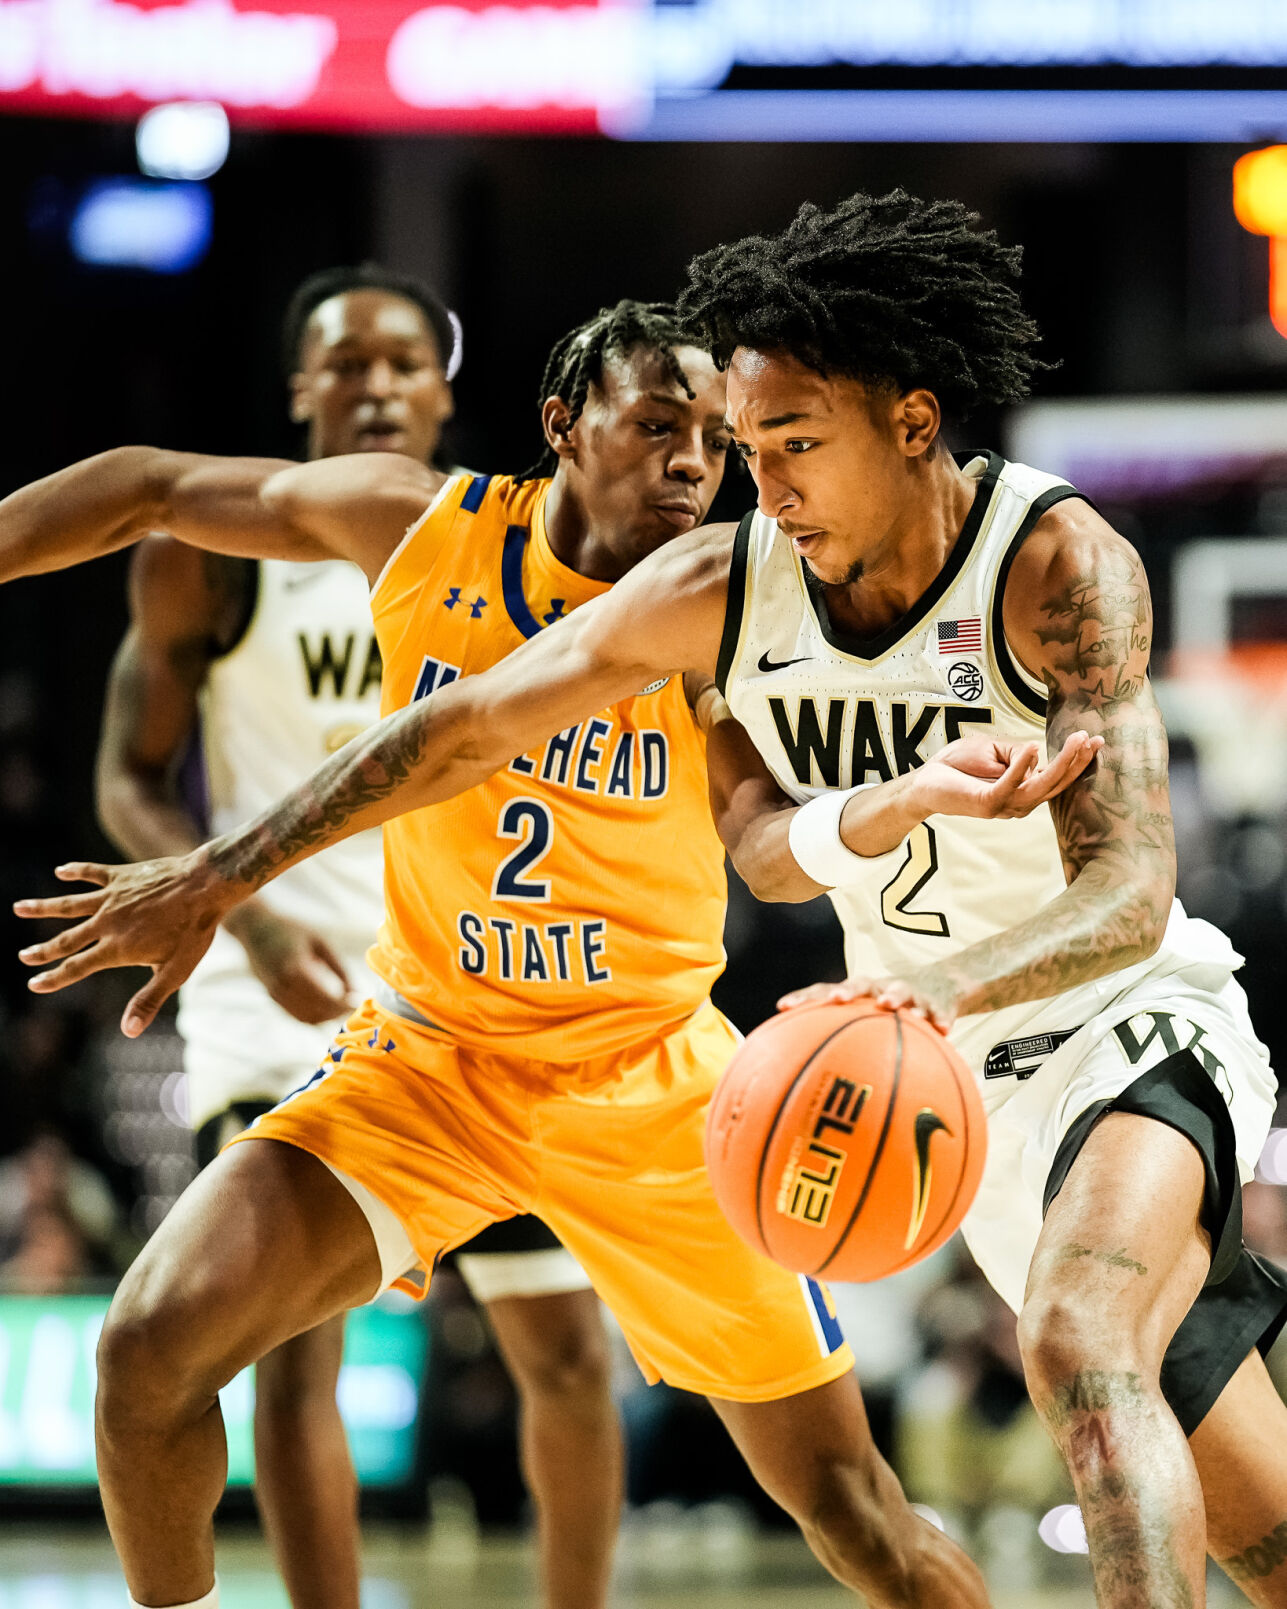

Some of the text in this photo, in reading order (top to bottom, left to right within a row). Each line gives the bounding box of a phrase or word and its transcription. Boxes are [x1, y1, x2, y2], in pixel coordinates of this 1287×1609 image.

[953, 673, 981, 685] ACC
[491, 796, 554, 903] 2
[881, 821, 950, 937] 2
[457, 910, 613, 985] STATE
[988, 1062, 1010, 1071] TEAM
[1011, 1037, 1049, 1050] ENGINEERED
[787, 1077, 873, 1229] ELITE
